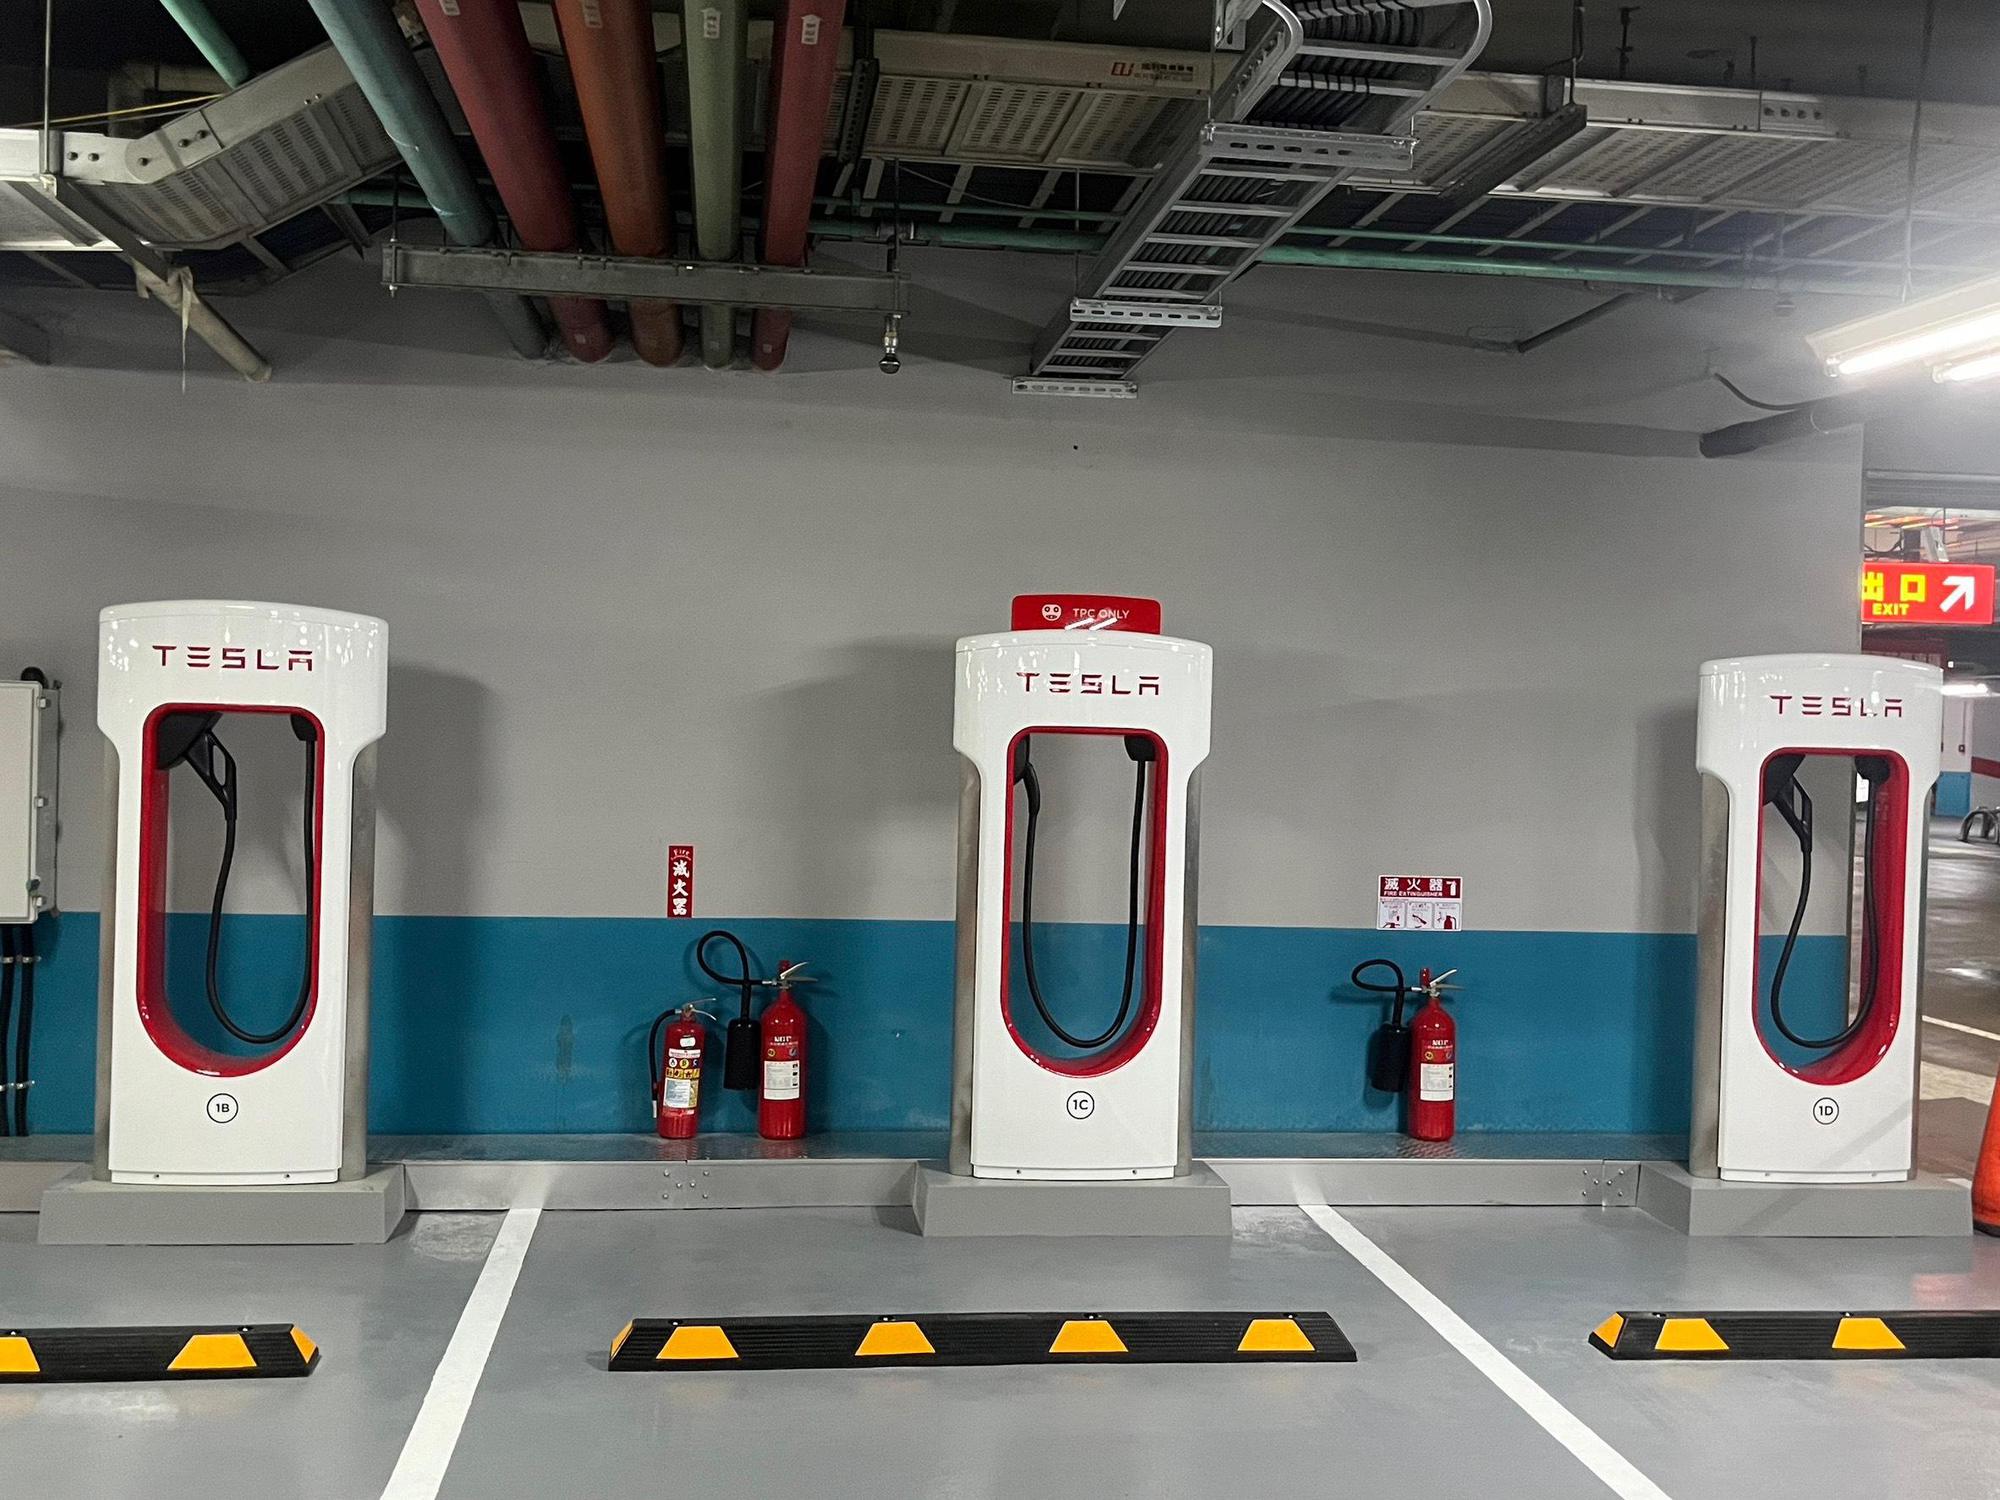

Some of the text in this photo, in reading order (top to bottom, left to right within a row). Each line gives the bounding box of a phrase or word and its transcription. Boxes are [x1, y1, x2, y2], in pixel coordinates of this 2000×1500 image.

[1862, 571, 1926, 602] 出口
[1072, 607, 1130, 620] TPC ONLY
[1872, 602, 1910, 616] EXIT
[152, 645, 313, 672] TESLA
[1016, 671, 1160, 696] TESLA
[1769, 695, 1904, 718] TESLA
[215, 1103, 230, 1113] 1B
[1072, 1099, 1089, 1110] 1C
[1818, 1105, 1834, 1116] 1D
